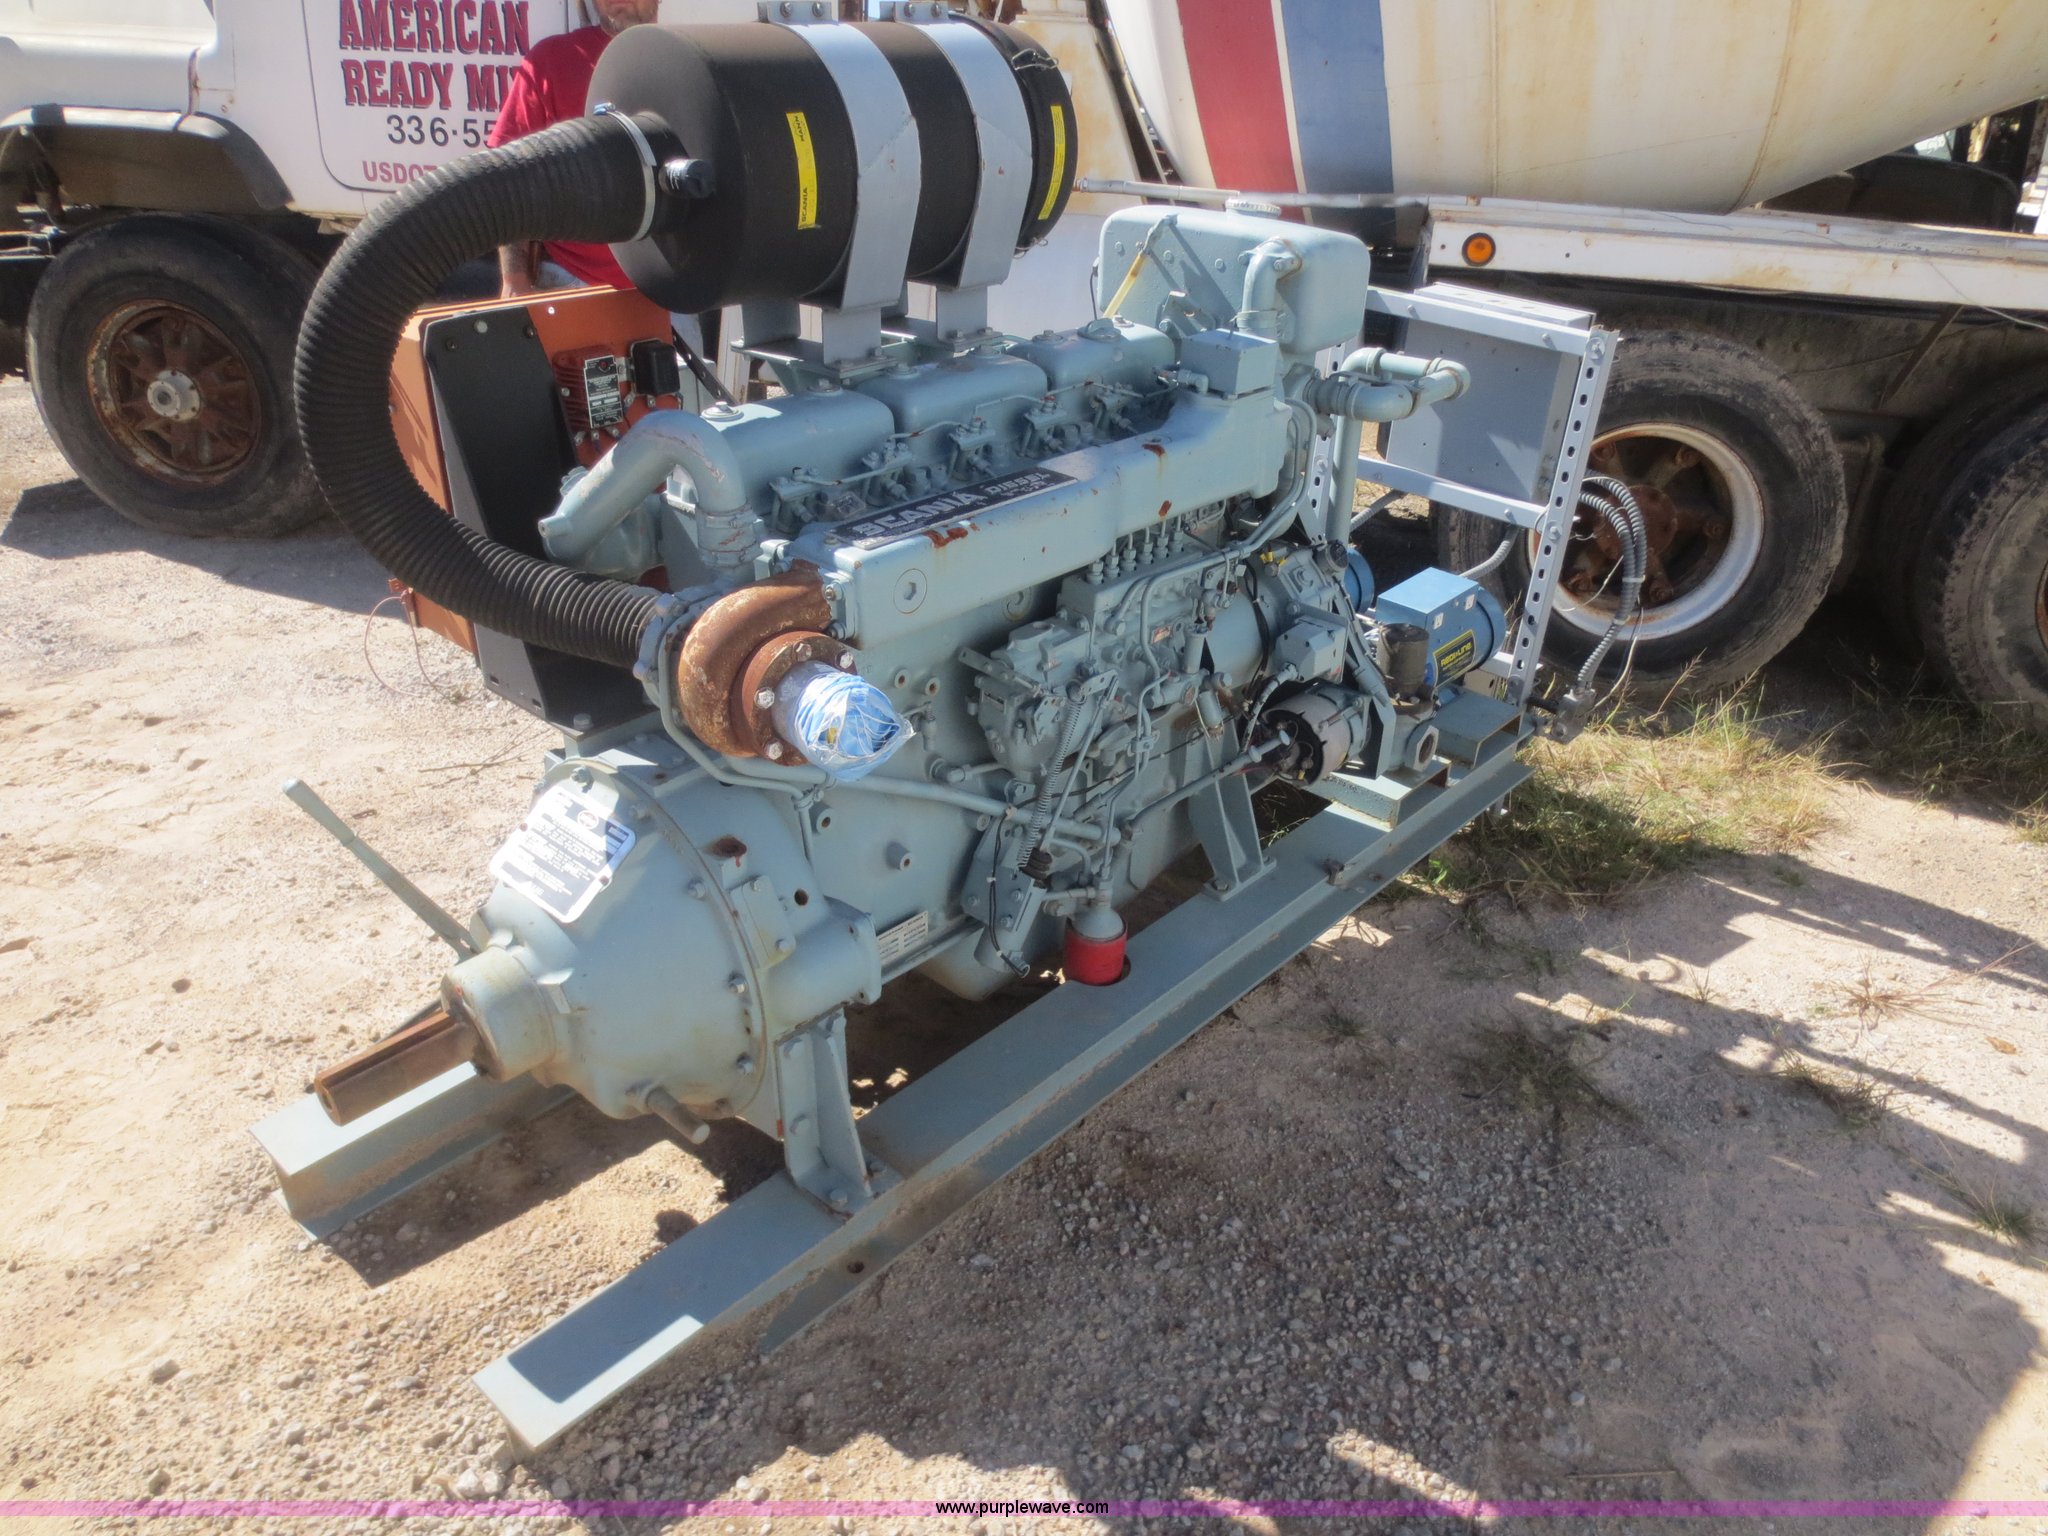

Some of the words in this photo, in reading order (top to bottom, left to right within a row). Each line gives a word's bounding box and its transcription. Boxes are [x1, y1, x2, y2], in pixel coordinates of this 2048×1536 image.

[339, 0, 530, 55] AMERICAN
[341, 58, 454, 111] READY
[463, 62, 523, 112] MI
[852, 490, 988, 537] SCANIA
